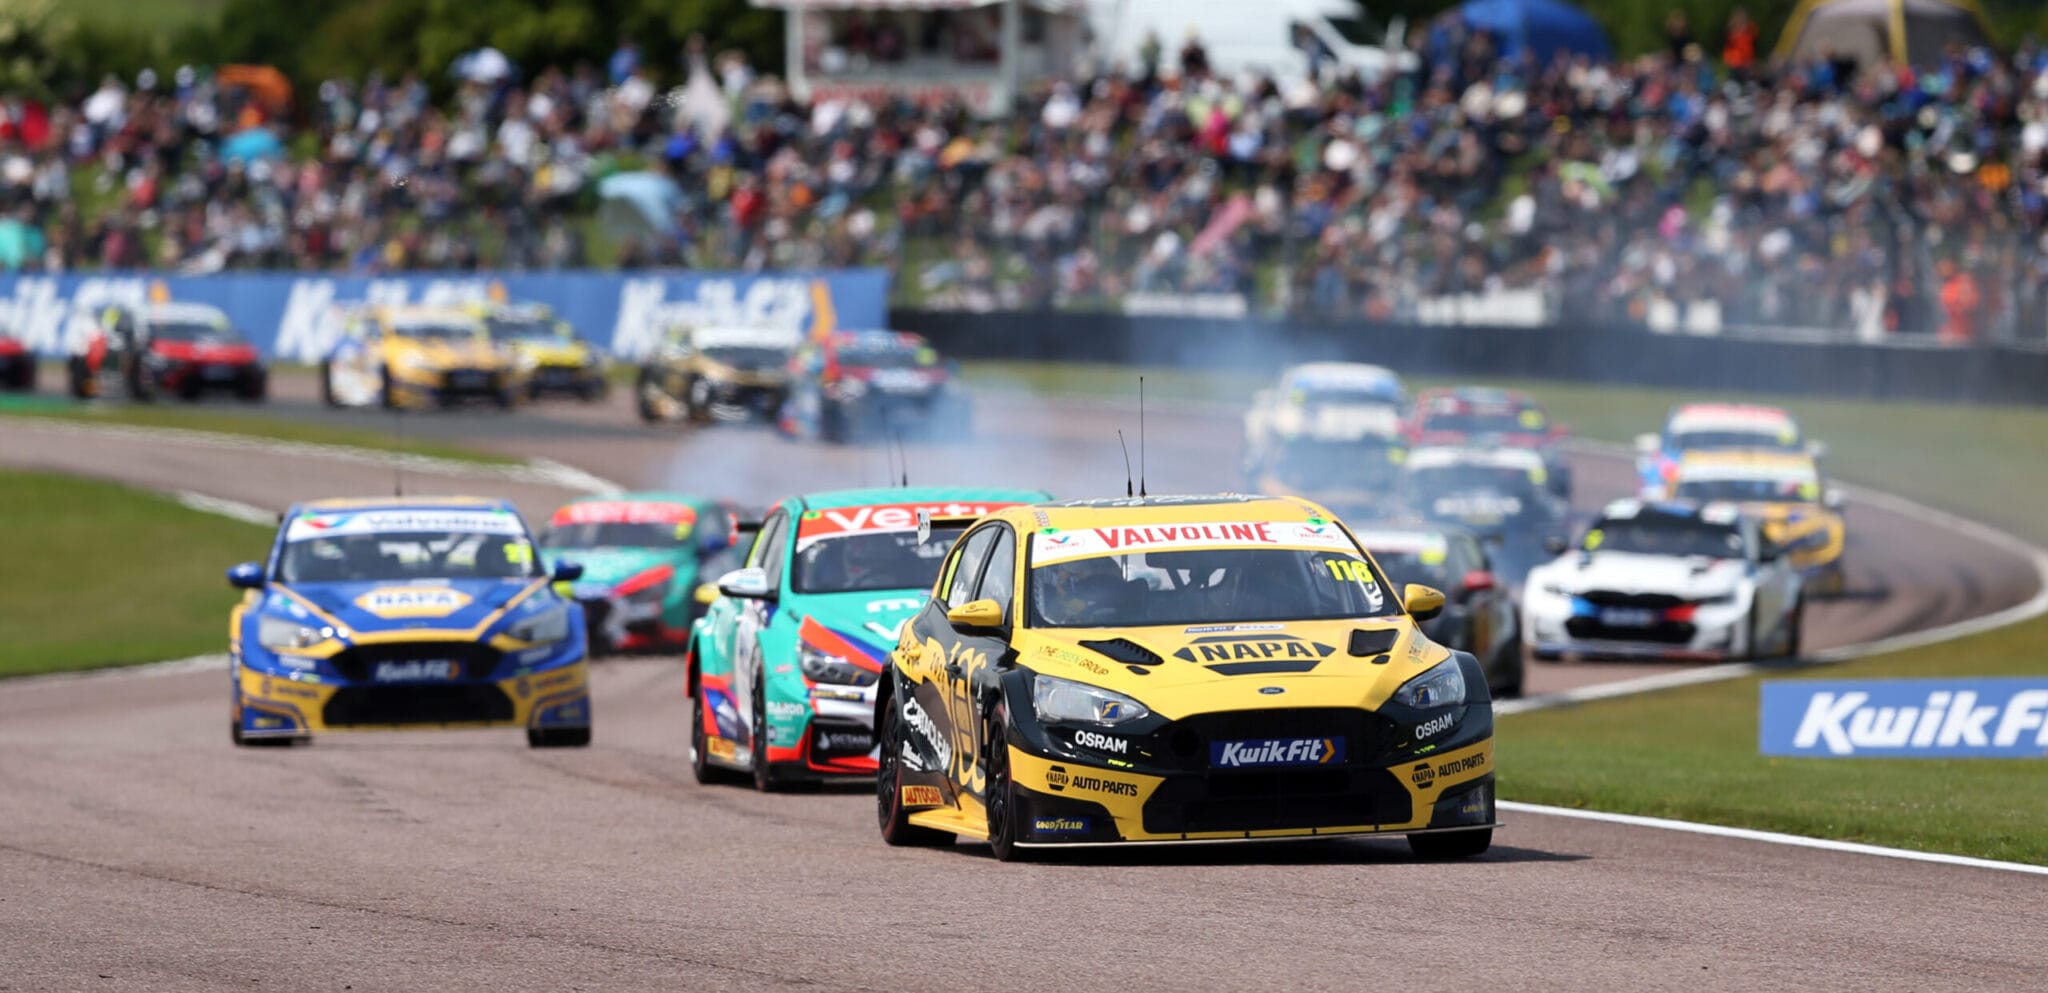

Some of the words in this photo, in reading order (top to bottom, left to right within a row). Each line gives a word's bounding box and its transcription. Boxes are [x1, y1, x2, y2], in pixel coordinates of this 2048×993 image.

[1094, 521, 1277, 549] VALVOLINE
[1325, 559, 1375, 583] 116
[1199, 642, 1313, 661] NAPA
[1415, 713, 1453, 739] OSRAM
[1075, 730, 1128, 753] OSRAM
[1220, 739, 1322, 766] KwikFit
[1438, 761, 1461, 778] AUTO
[1462, 752, 1485, 771] PARTS
[1072, 776, 1100, 791] AUTO
[1102, 780, 1138, 796] PARTS
[1036, 818, 1083, 831] GOODYEAR
